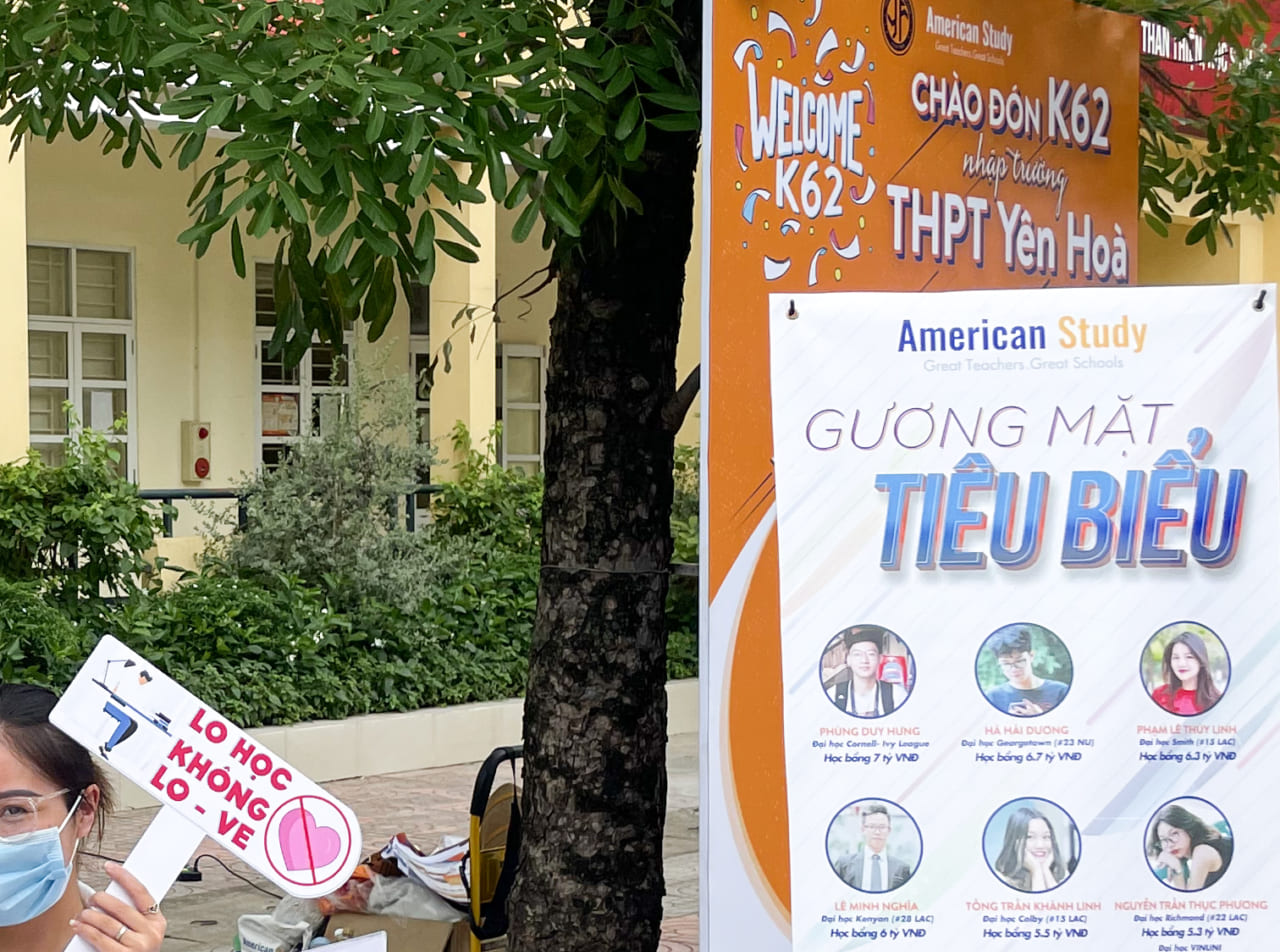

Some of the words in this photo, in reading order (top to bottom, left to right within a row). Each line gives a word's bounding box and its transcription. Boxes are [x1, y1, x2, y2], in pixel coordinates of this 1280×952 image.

[926, 6, 979, 44] American
[982, 20, 1013, 57] Study
[747, 61, 865, 177] WELCOME
[912, 70, 983, 124] CHÀO
[988, 86, 1042, 136] ĐÓN
[1048, 76, 1110, 151] K62
[774, 158, 845, 219] K62
[963, 134, 1006, 197] nhập
[1005, 145, 1068, 220] trường
[887, 183, 989, 259] THPT
[995, 199, 1056, 272] Yên
[1066, 212, 1128, 283] Hoà
[898, 318, 1047, 353] American
[1058, 315, 1148, 354] Study
[805, 401, 1028, 451] GƯƠNG
[1047, 394, 1174, 457] MẶT
[874, 452, 1052, 571] TIÊU
[1060, 427, 1248, 571] BIỂU
[167, 739, 270, 821] KHÔNG
[188, 707, 228, 744] LO
[230, 737, 293, 791] HỌC
[149, 765, 190, 802] LO
[217, 811, 255, 851] VE
[849, 902, 879, 911] MINH
